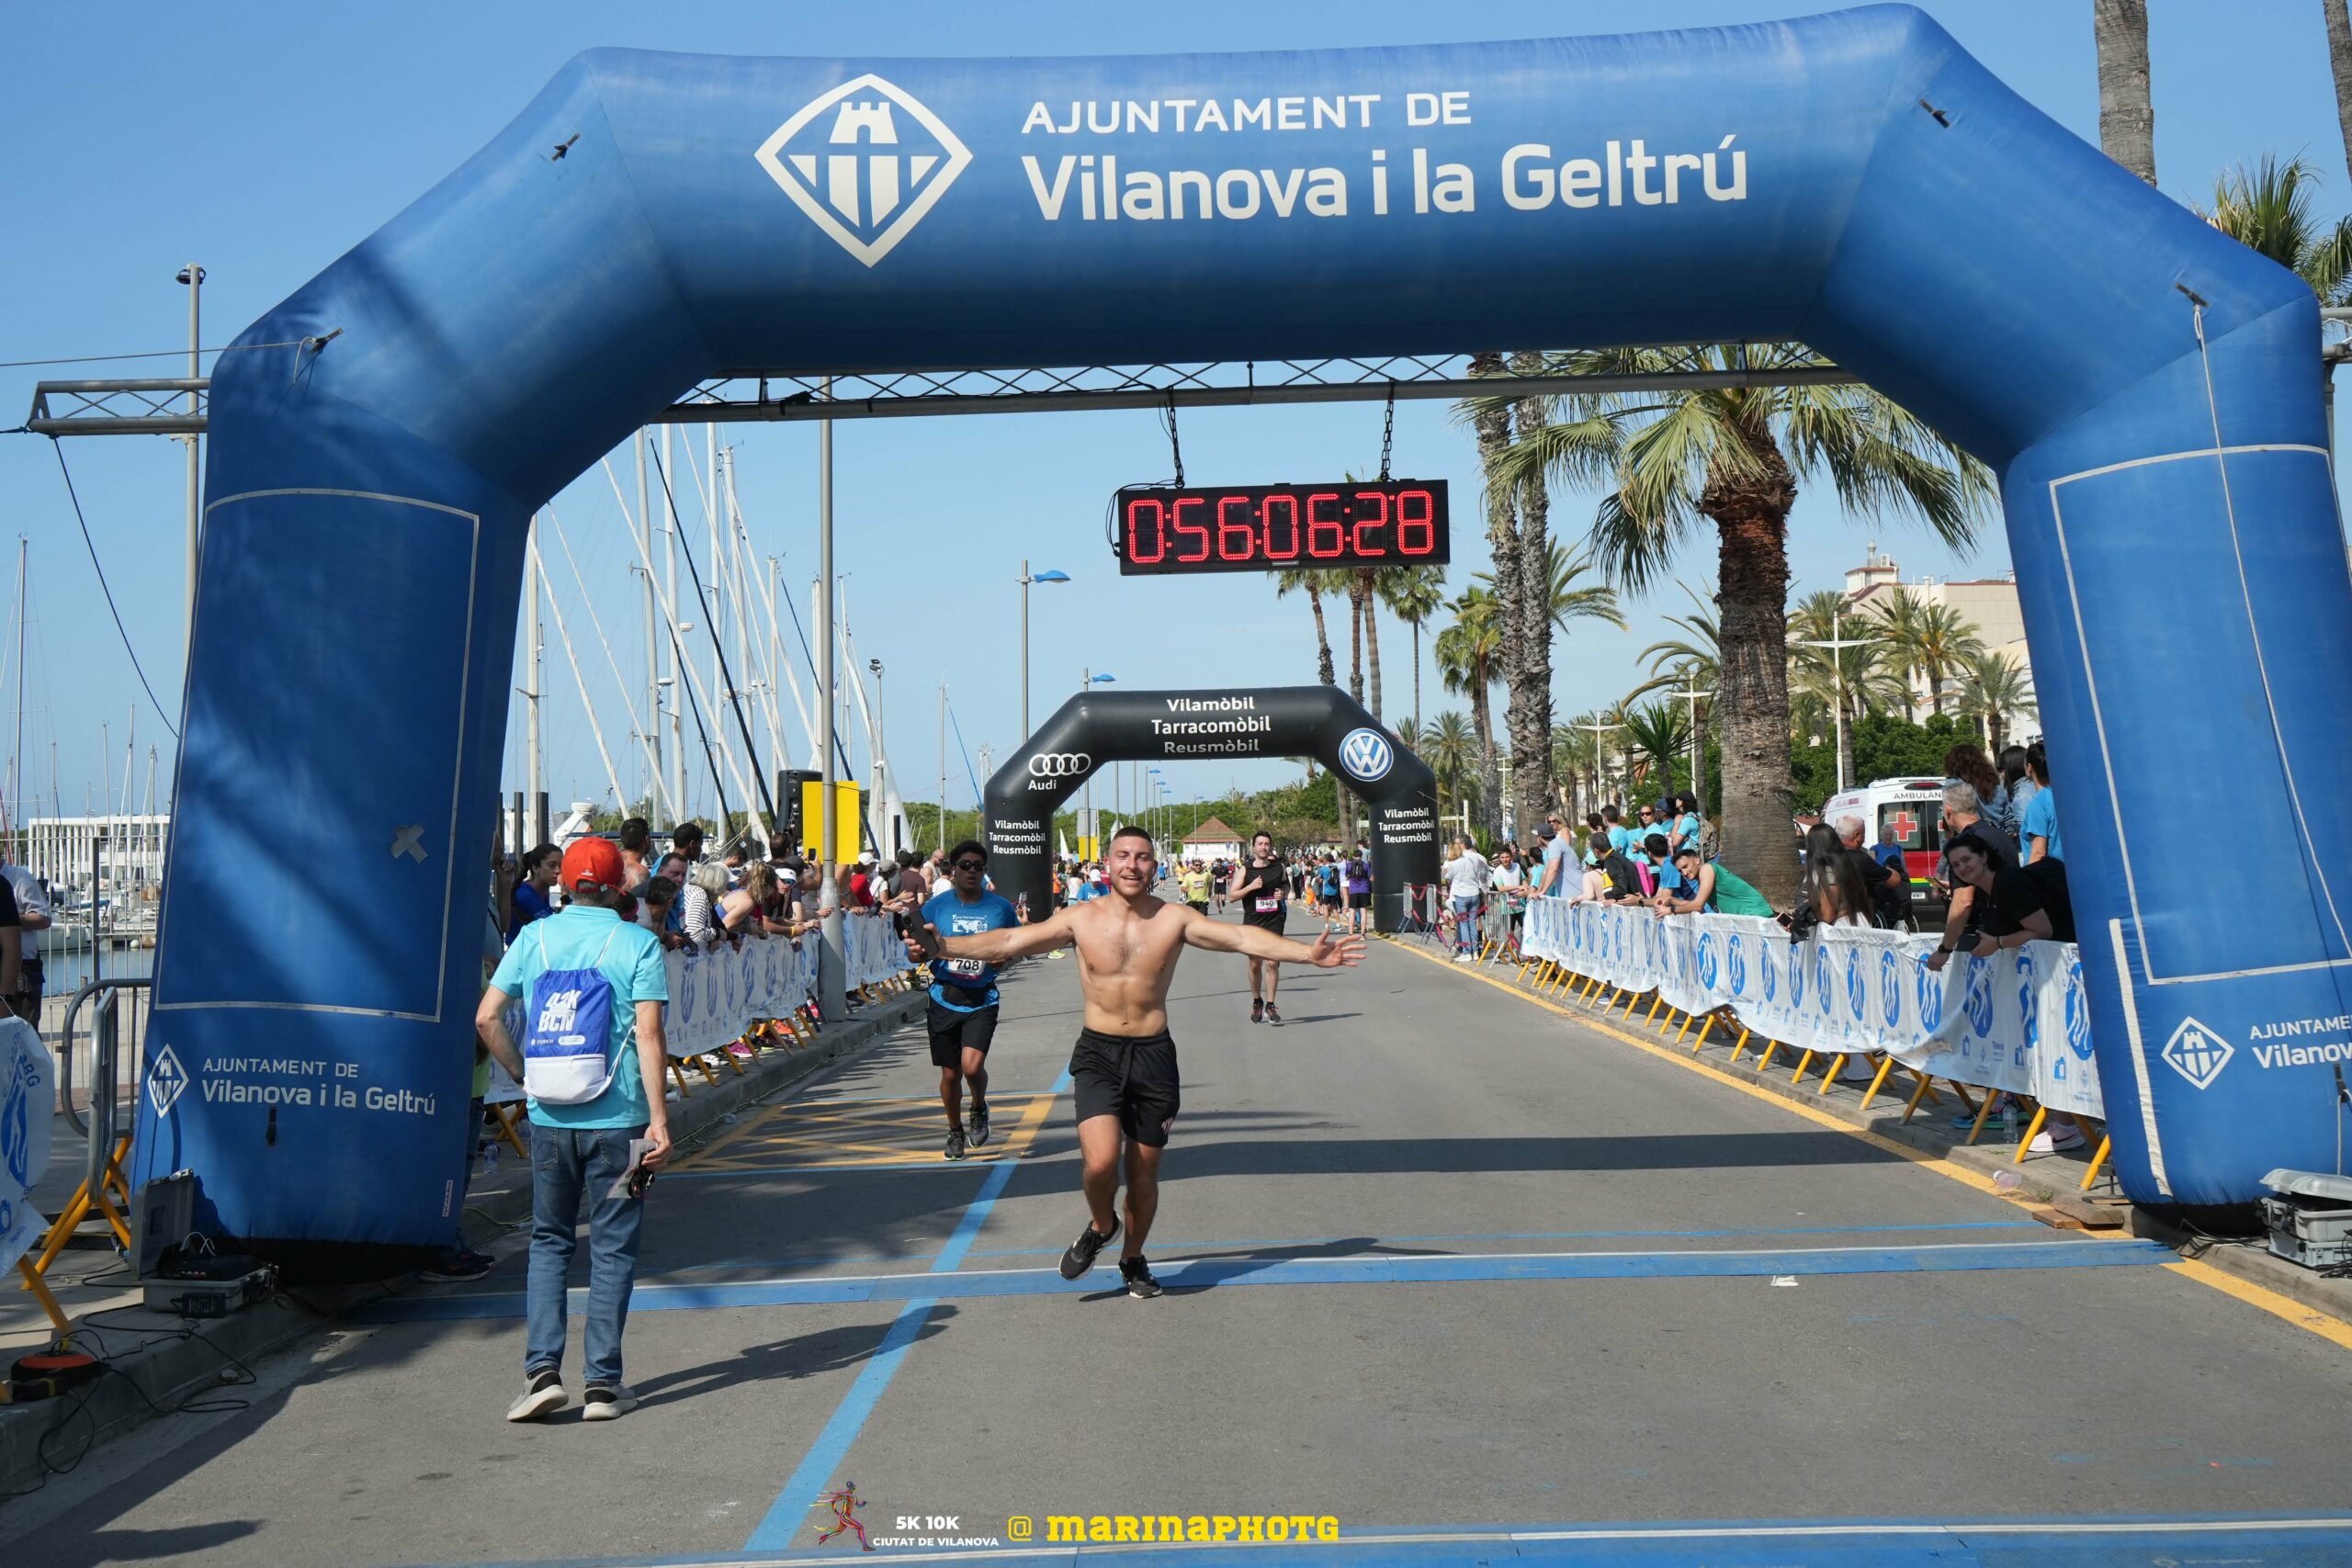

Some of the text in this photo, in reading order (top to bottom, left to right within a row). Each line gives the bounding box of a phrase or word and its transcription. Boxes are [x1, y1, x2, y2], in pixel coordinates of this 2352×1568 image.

[1022, 91, 1471, 134] AJUNTAMENT DE
[1021, 134, 1747, 221] Vilanova i la Geltrú
[1166, 696, 1255, 712] Vilamòbil
[1151, 716, 1271, 735] Tarracomòbil
[1164, 739, 1260, 753] Reusmòbil
[1028, 780, 1057, 790] Audi
[1384, 807, 1429, 818] Vilamòbil
[995, 820, 1040, 829] Vilamòbil
[1378, 820, 1434, 831] Tarracomòbil
[989, 832, 1046, 842] Tarracomòbil
[1384, 832, 1431, 843] Reusmòbil
[993, 845, 1041, 854] Reusmòbil
[956, 959, 979, 971] 708
[545, 989, 582, 1010] 42K
[537, 1010, 576, 1032] BCN
[2249, 1014, 2352, 1040] AJUNTAME
[202, 1058, 358, 1078] AJUNTAMENT DE
[202, 1079, 435, 1115] Vilanova i la Geltrú
